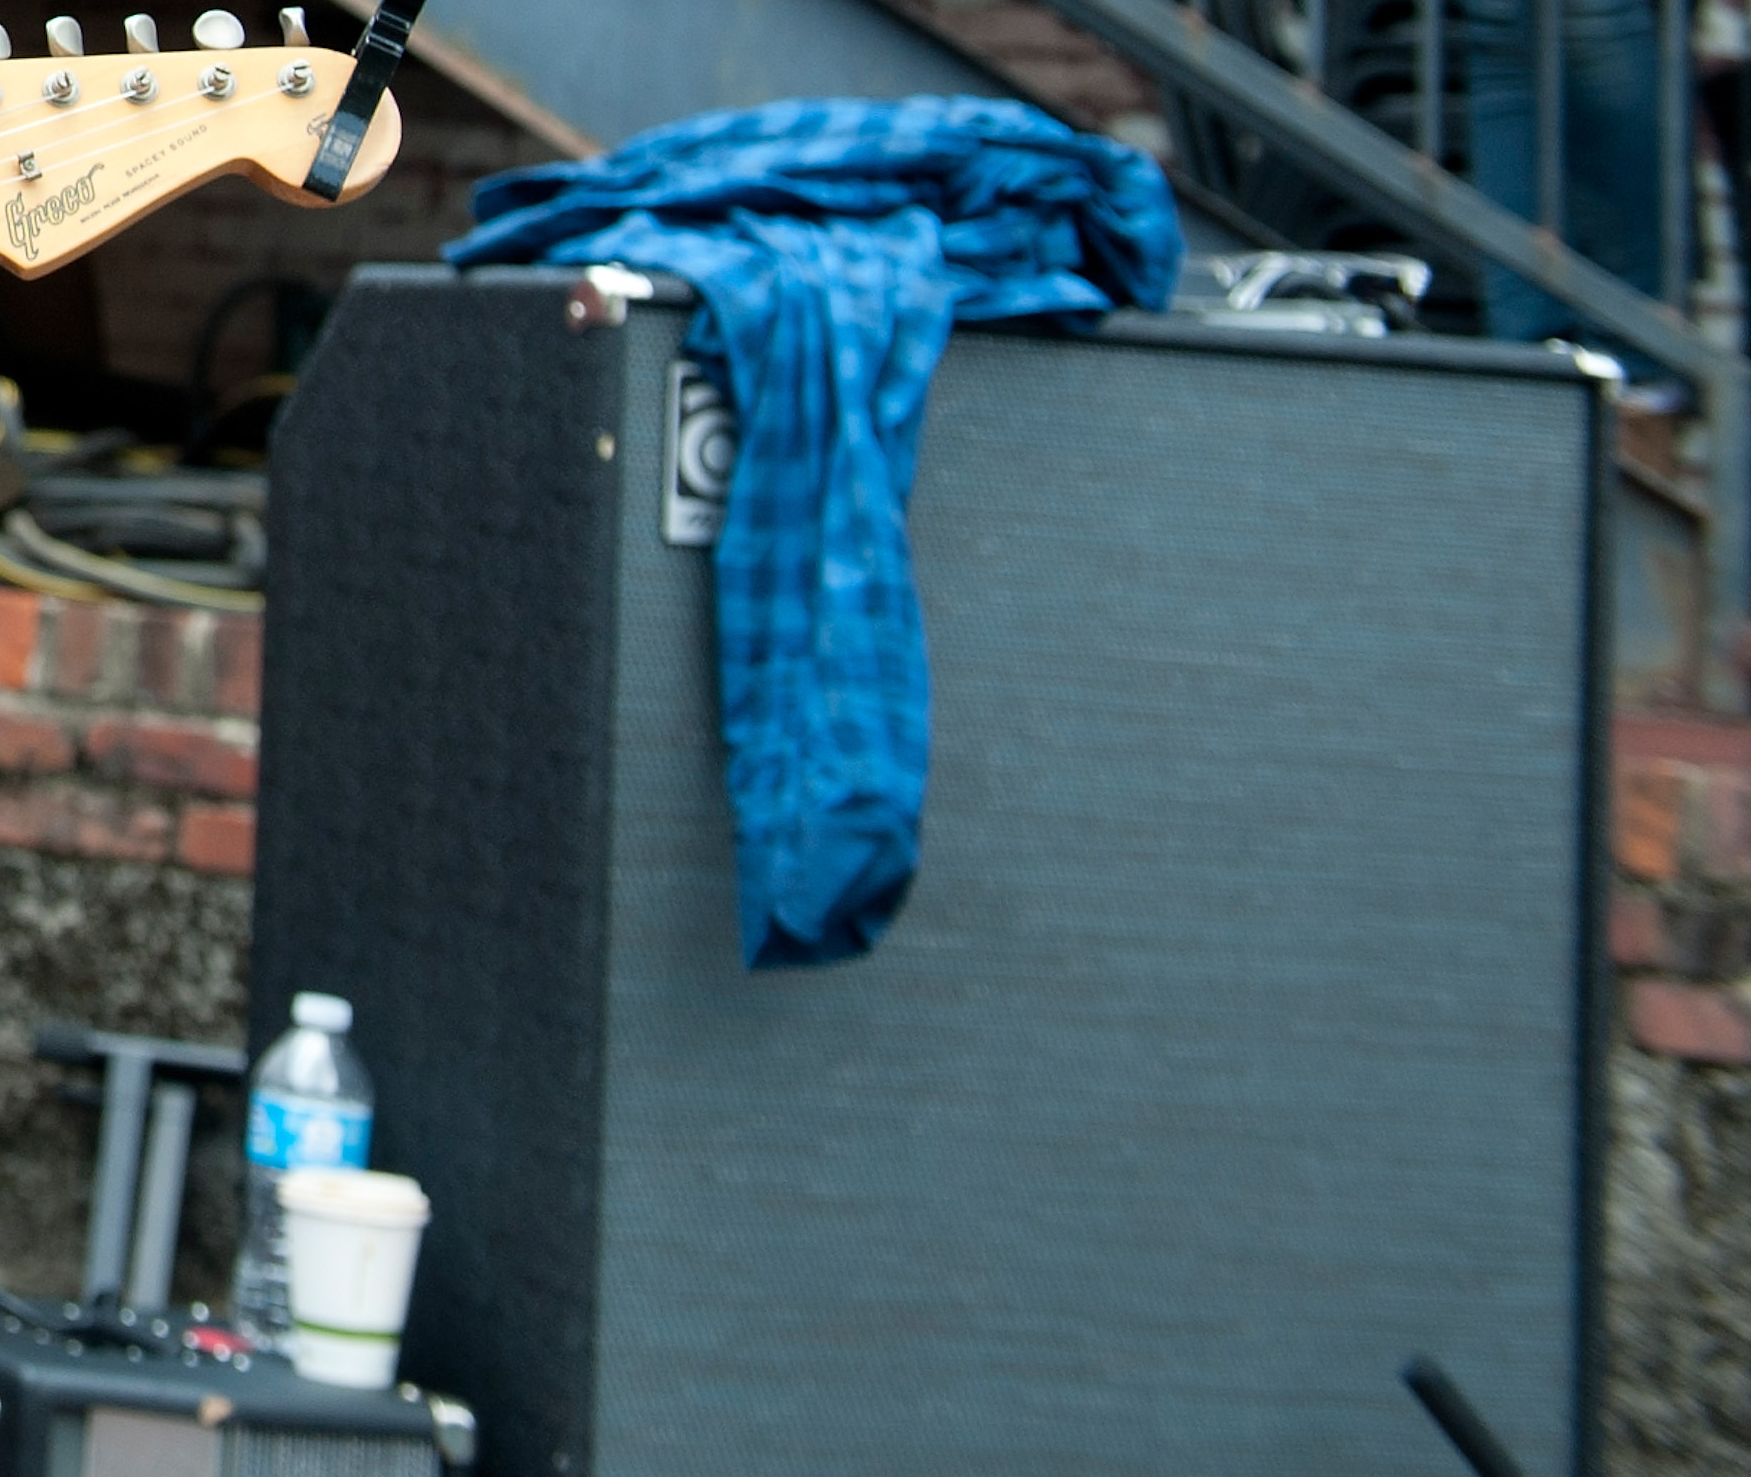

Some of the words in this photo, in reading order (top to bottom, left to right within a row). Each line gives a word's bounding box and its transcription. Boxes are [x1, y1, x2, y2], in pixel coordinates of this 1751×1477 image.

[125, 150, 167, 177] SPACEY
[168, 124, 208, 151] SOUND
[4, 162, 105, 261] Greco
